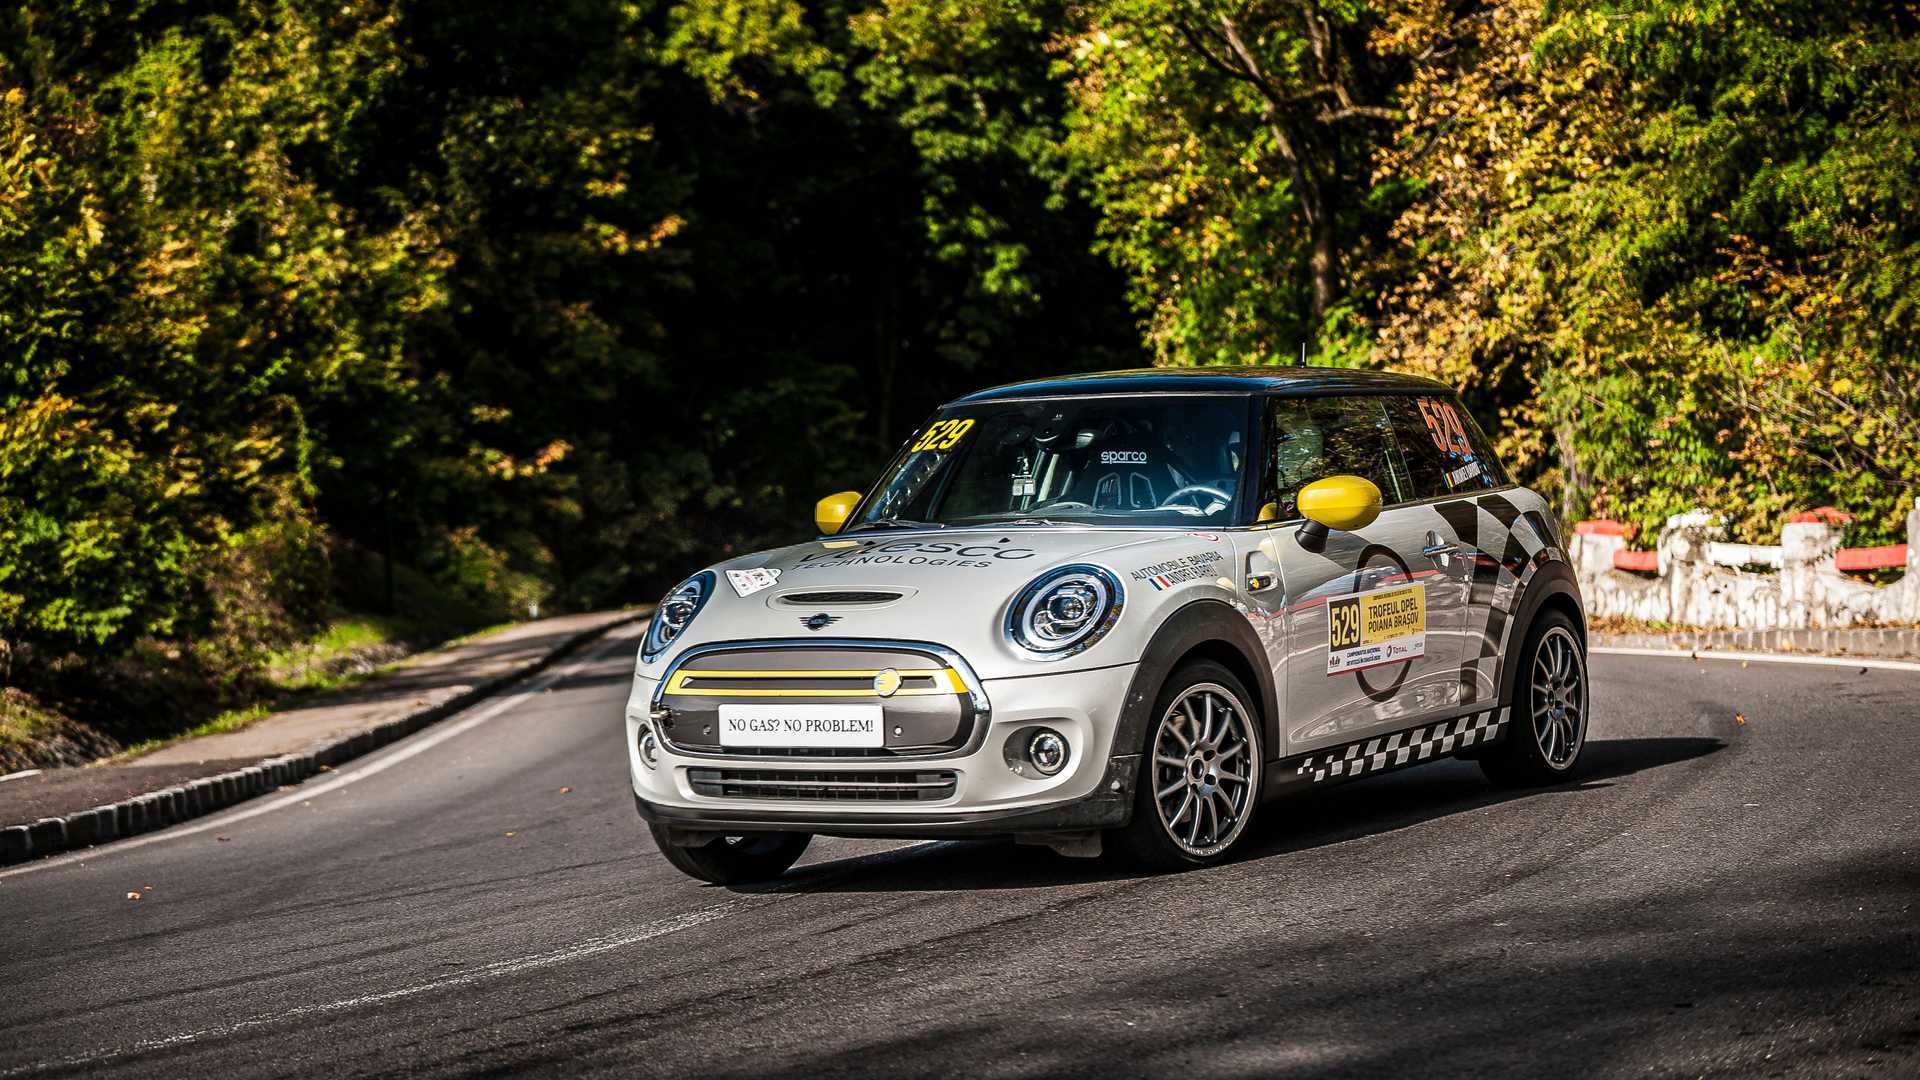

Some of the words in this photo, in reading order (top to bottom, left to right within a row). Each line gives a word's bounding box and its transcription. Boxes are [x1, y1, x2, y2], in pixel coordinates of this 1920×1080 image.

[911, 418, 976, 453] 529
[1416, 399, 1472, 455] 529
[1101, 450, 1148, 465] sparco
[791, 555, 993, 571] TECHNOLOGIES
[1130, 558, 1190, 581] AUTOMOBILE
[1186, 551, 1224, 566] BAVARIA
[1368, 601, 1400, 619] TROFEUL
[1401, 597, 1418, 613] OPEL
[1331, 604, 1359, 647] 529
[1368, 617, 1393, 633] POIANA
[728, 719, 746, 732] NO
[749, 719, 780, 732] GAS?
[783, 719, 801, 732] NO
[806, 719, 874, 733] PROBLEM!
